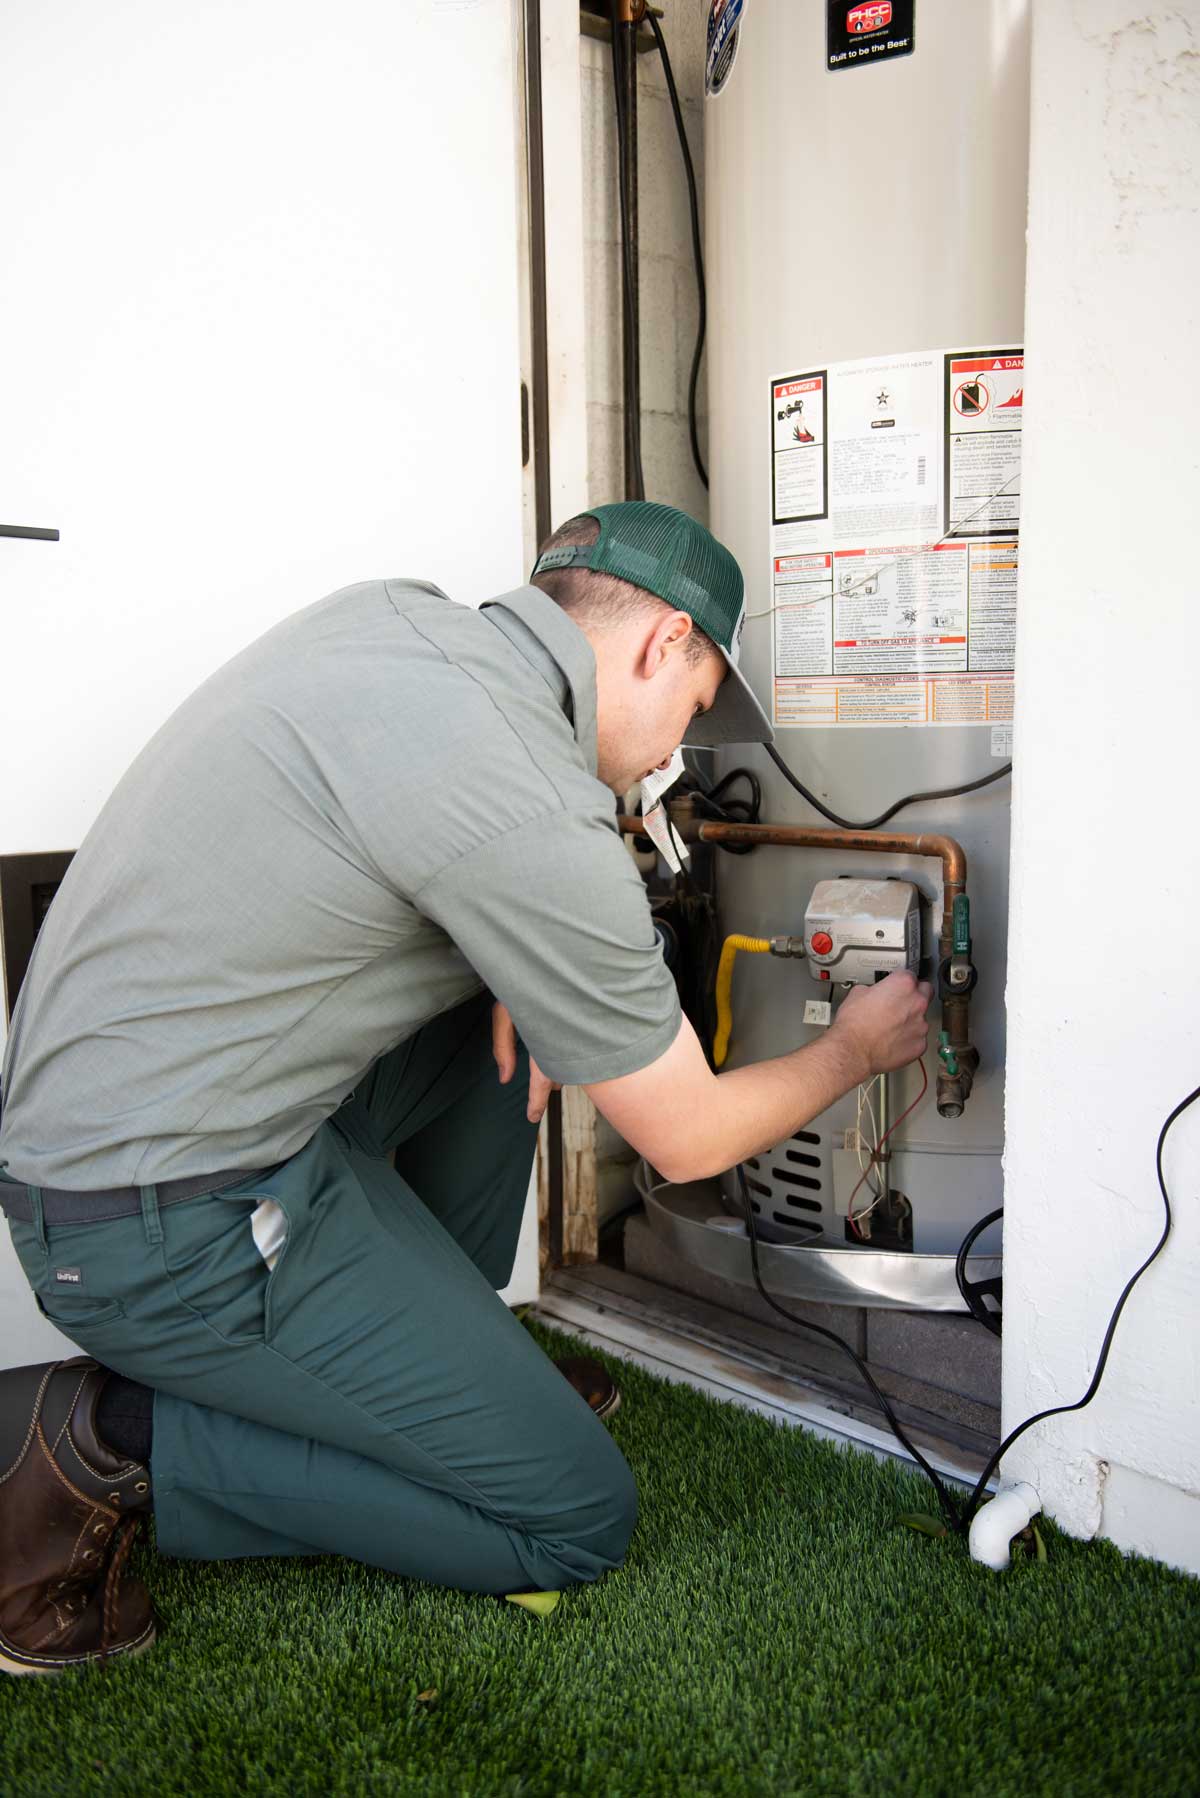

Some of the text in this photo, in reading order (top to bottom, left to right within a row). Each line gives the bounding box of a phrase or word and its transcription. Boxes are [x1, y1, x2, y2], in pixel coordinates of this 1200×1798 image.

[848, 4, 889, 22] PHCC
[830, 53, 847, 63] Built
[858, 47, 870, 56] be
[871, 44, 885, 53] the
[887, 39, 907, 49] Best
[1005, 360, 1024, 368] DAN
[788, 382, 817, 394] DANGER
